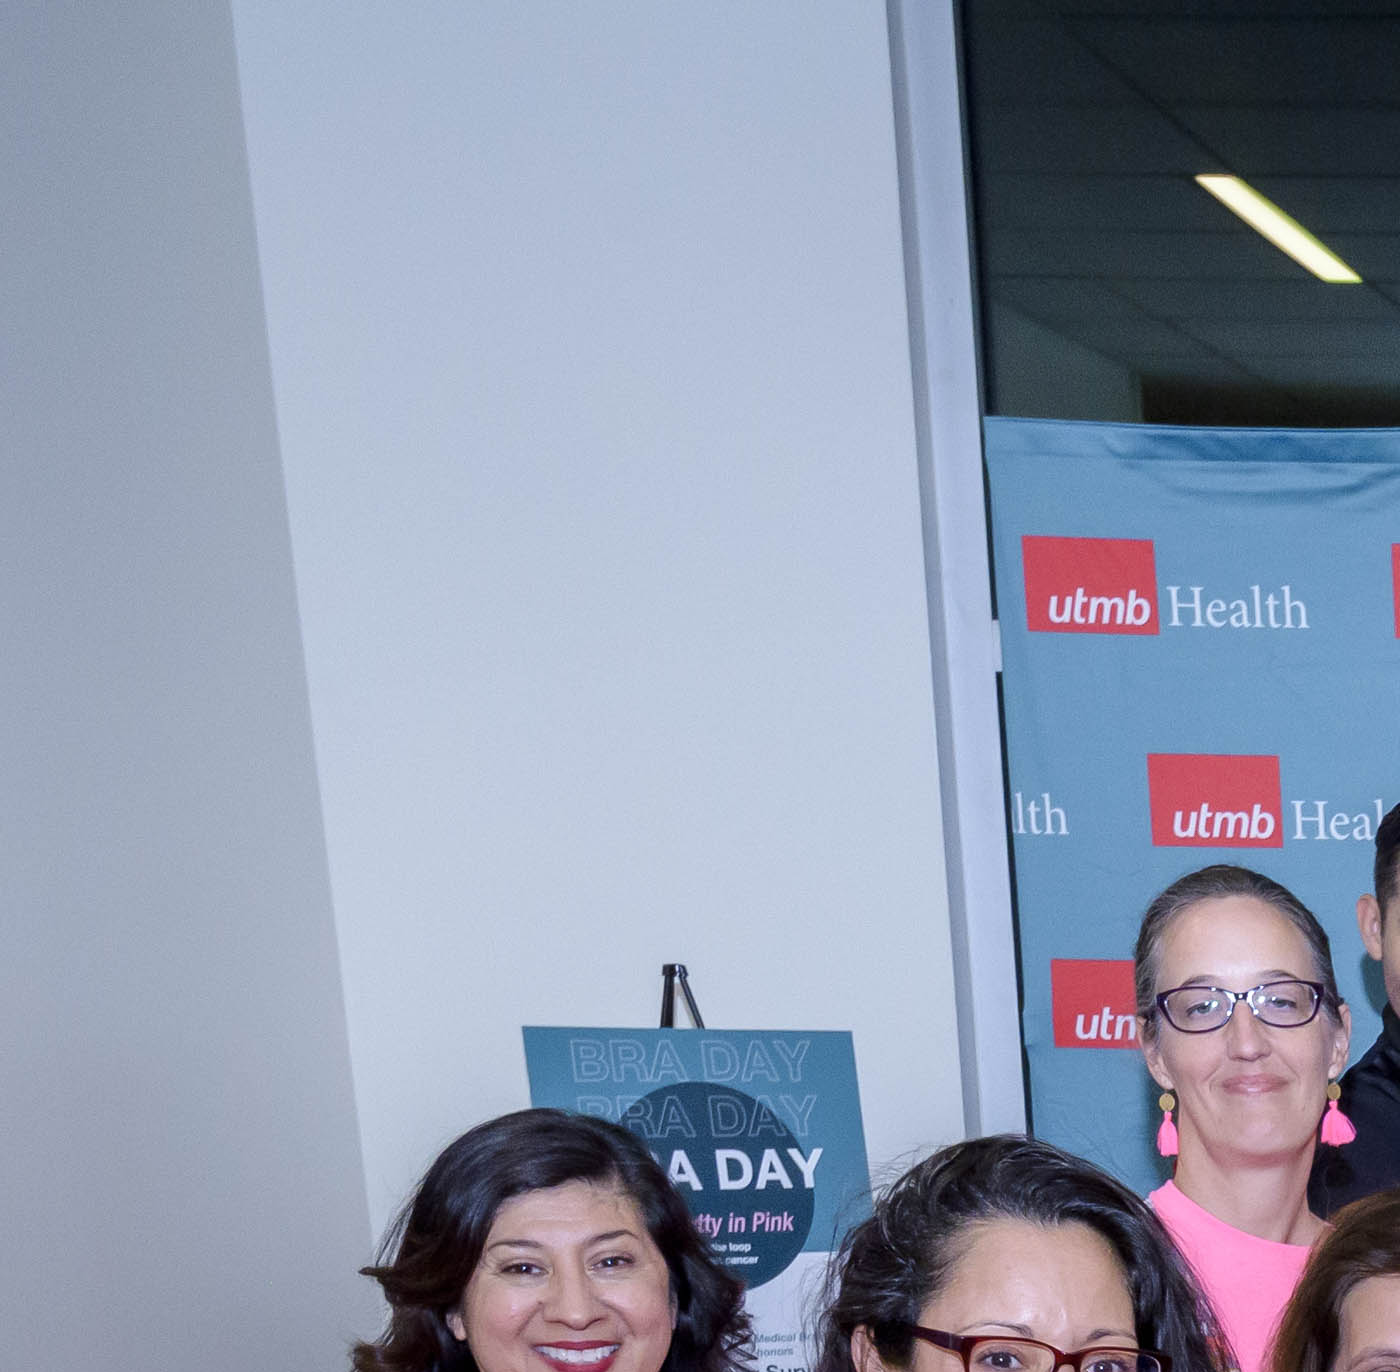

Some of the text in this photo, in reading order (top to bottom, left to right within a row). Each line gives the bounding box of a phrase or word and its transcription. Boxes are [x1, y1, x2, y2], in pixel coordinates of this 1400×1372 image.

[1048, 585, 1309, 629] utmb Health
[1014, 792, 1070, 835] lth
[1173, 798, 1383, 841] utmb Heal
[1075, 1006, 1137, 1040] utm
[570, 1039, 811, 1083] BRA DAY
[707, 1094, 817, 1137] DAY
[714, 1148, 823, 1191] DAY
[728, 1212, 747, 1233] in
[752, 1211, 794, 1233] Pink
[729, 1242, 752, 1253] loop
